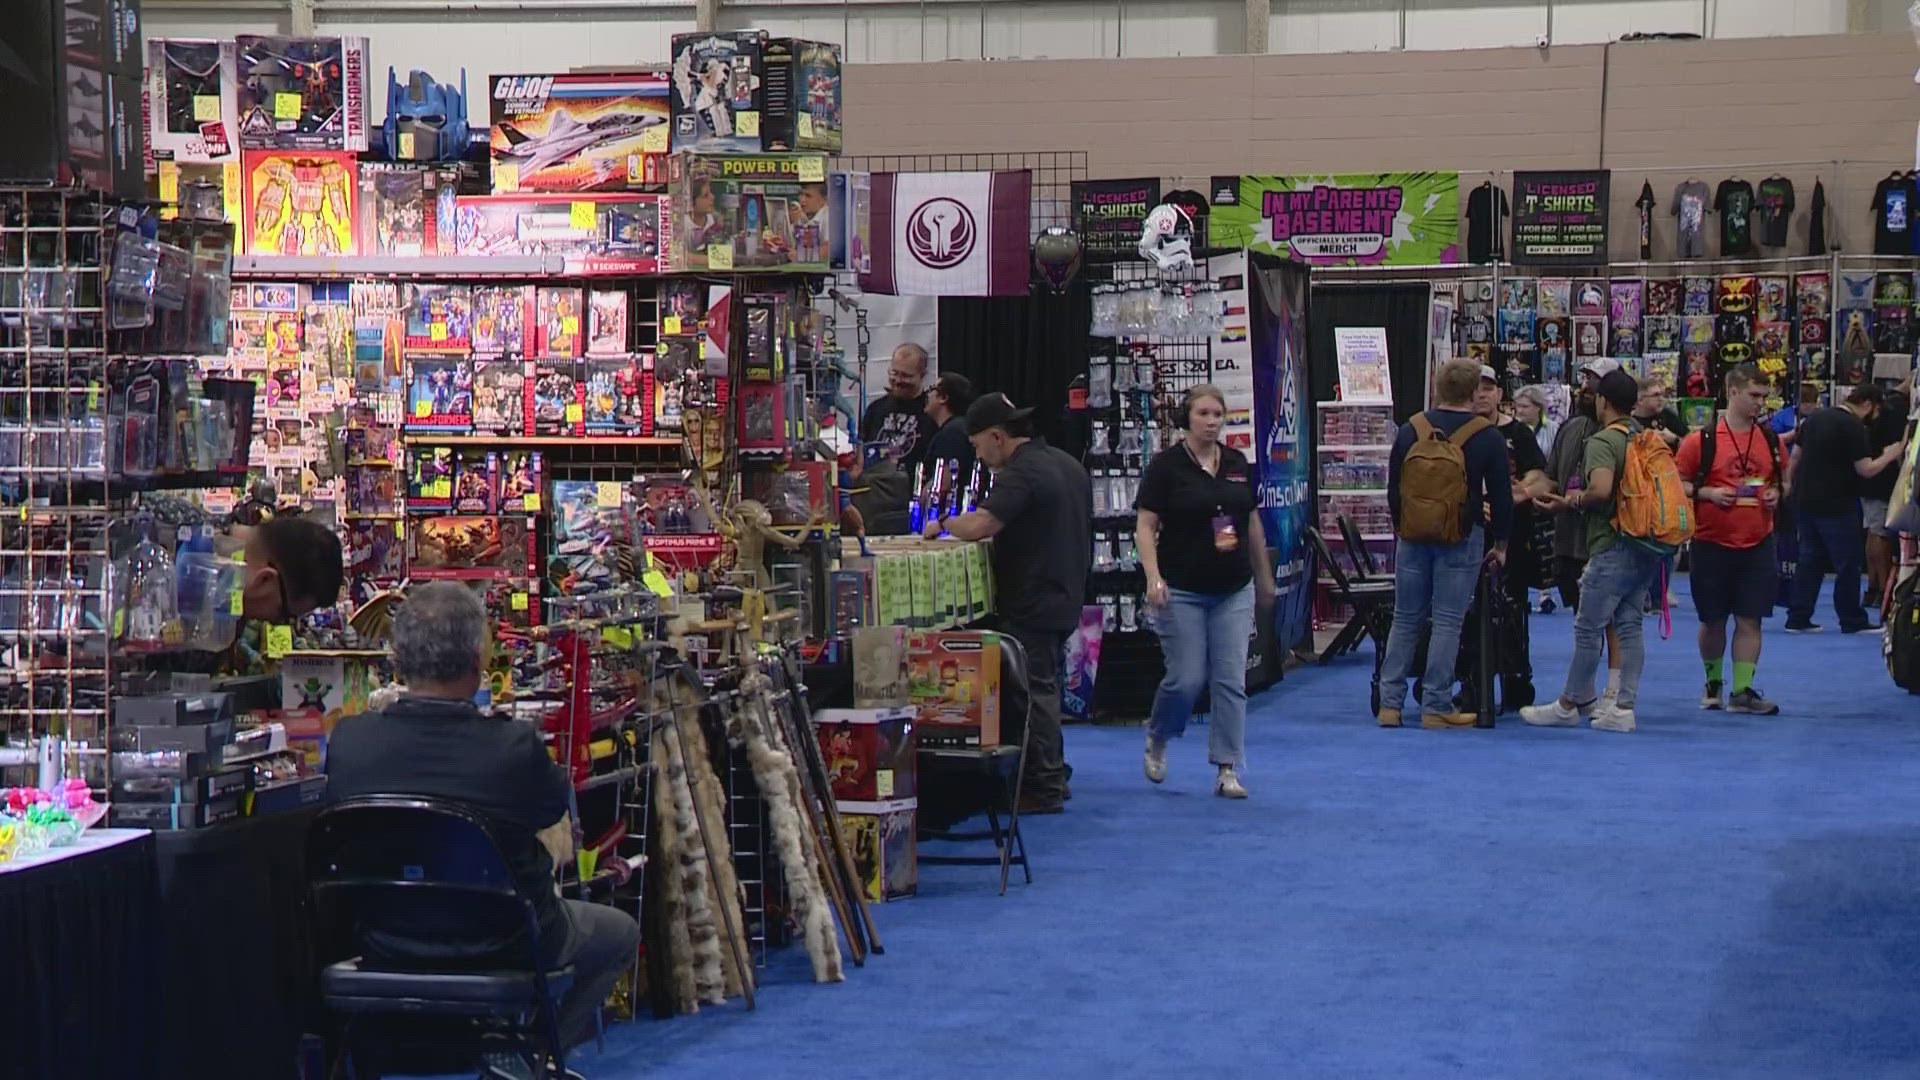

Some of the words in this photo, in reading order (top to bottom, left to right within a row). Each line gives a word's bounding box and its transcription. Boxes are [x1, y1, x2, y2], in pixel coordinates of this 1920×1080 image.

[346, 49, 362, 137] TRANSFORMERS
[723, 159, 777, 176] POWER
[781, 161, 799, 175] DO
[1083, 189, 1147, 204] LICENSED
[1526, 182, 1596, 196] LICENSED
[1263, 192, 1285, 217] IN
[1290, 194, 1311, 210] MY
[1314, 187, 1402, 210] PARENTS
[1525, 194, 1595, 214] T-SHIRTS
[1082, 202, 1147, 222] T-SHIRTS
[1273, 209, 1395, 240] BASEMENT
[659, 199, 672, 270] TRANSFORMERS
[1523, 234, 1540, 242] FOR
[1319, 244, 1357, 254] MERCH
[600, 262, 637, 271] SIDESWIPE
[641, 373, 655, 436] TRANSFORMERS
[654, 538, 685, 546] OPTIMUS
[685, 538, 707, 546] PRIME
